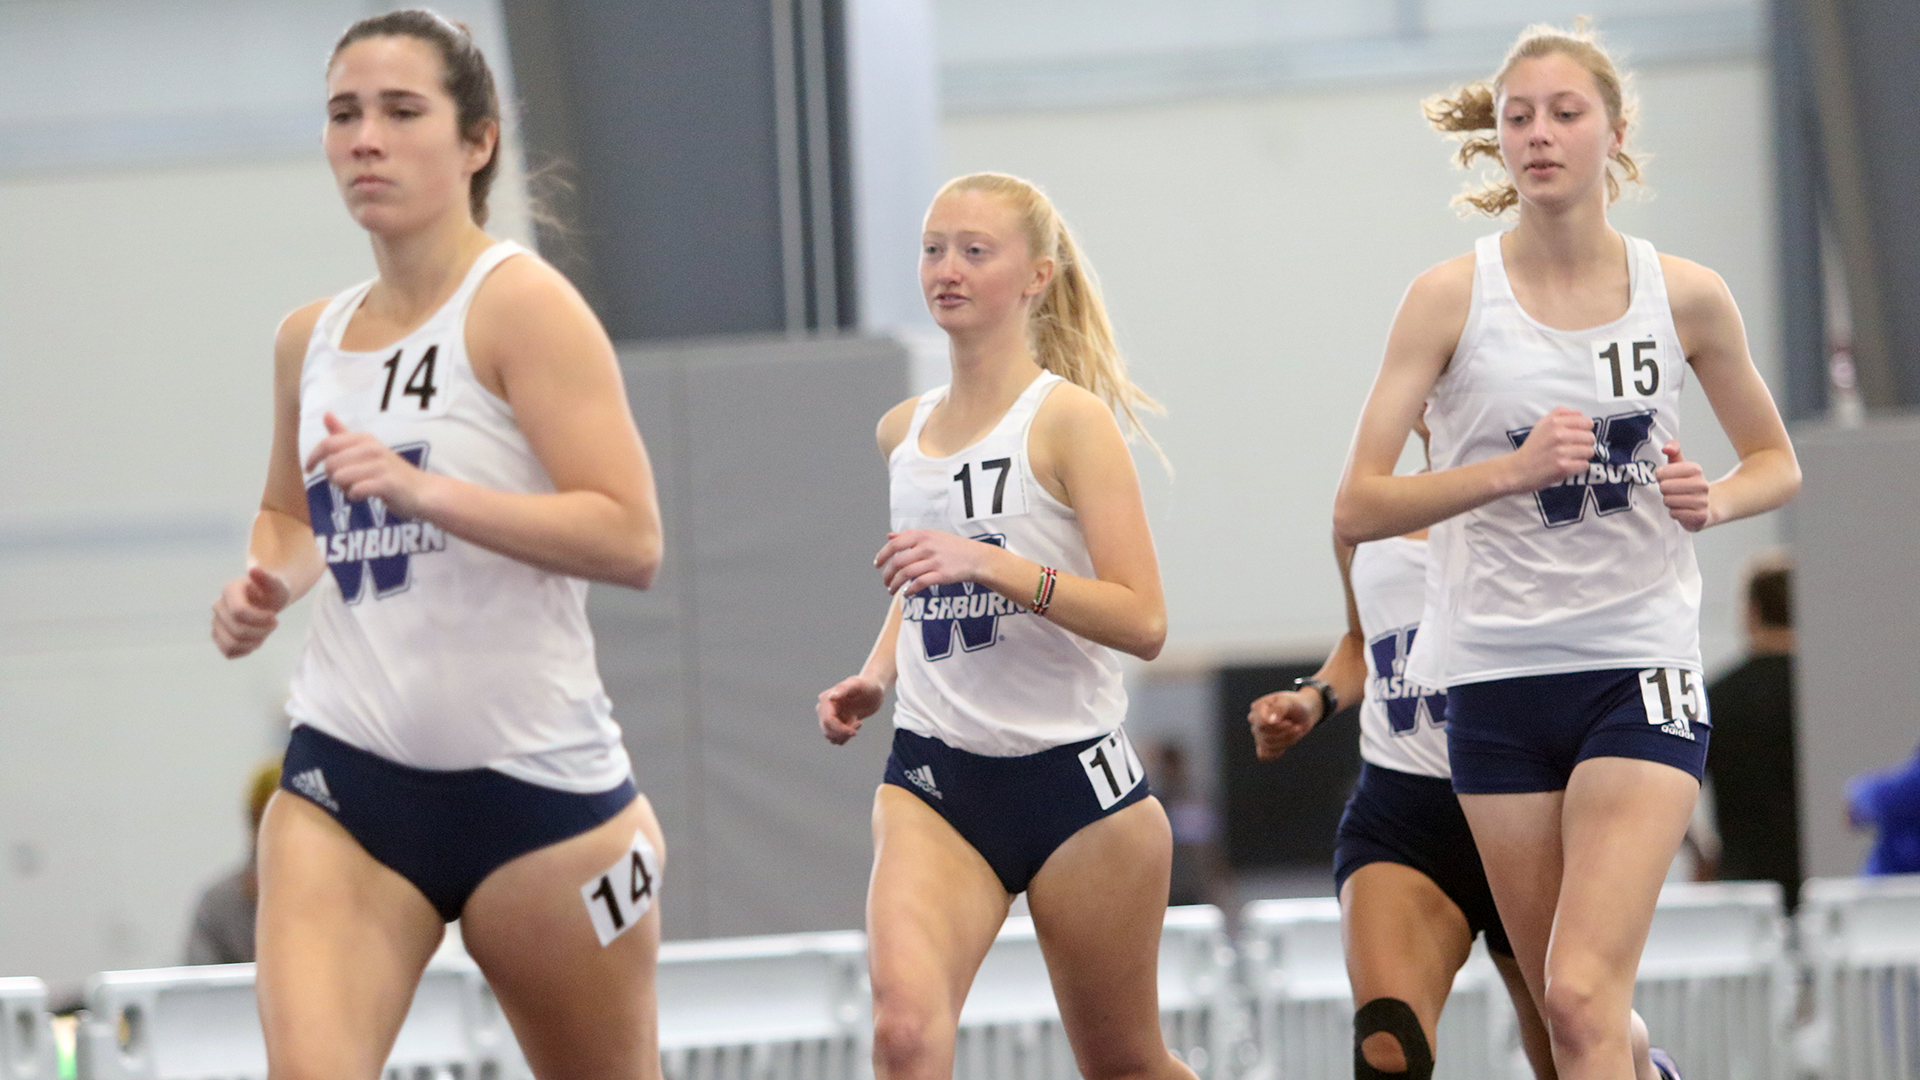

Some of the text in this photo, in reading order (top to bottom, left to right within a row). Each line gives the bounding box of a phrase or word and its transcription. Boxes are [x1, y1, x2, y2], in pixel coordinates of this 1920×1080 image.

[380, 344, 439, 412] 14
[1599, 341, 1659, 397] 15
[953, 457, 1012, 519] 17
[1646, 667, 1701, 721] 15
[1661, 724, 1695, 741] adidas
[591, 850, 653, 930] 14
